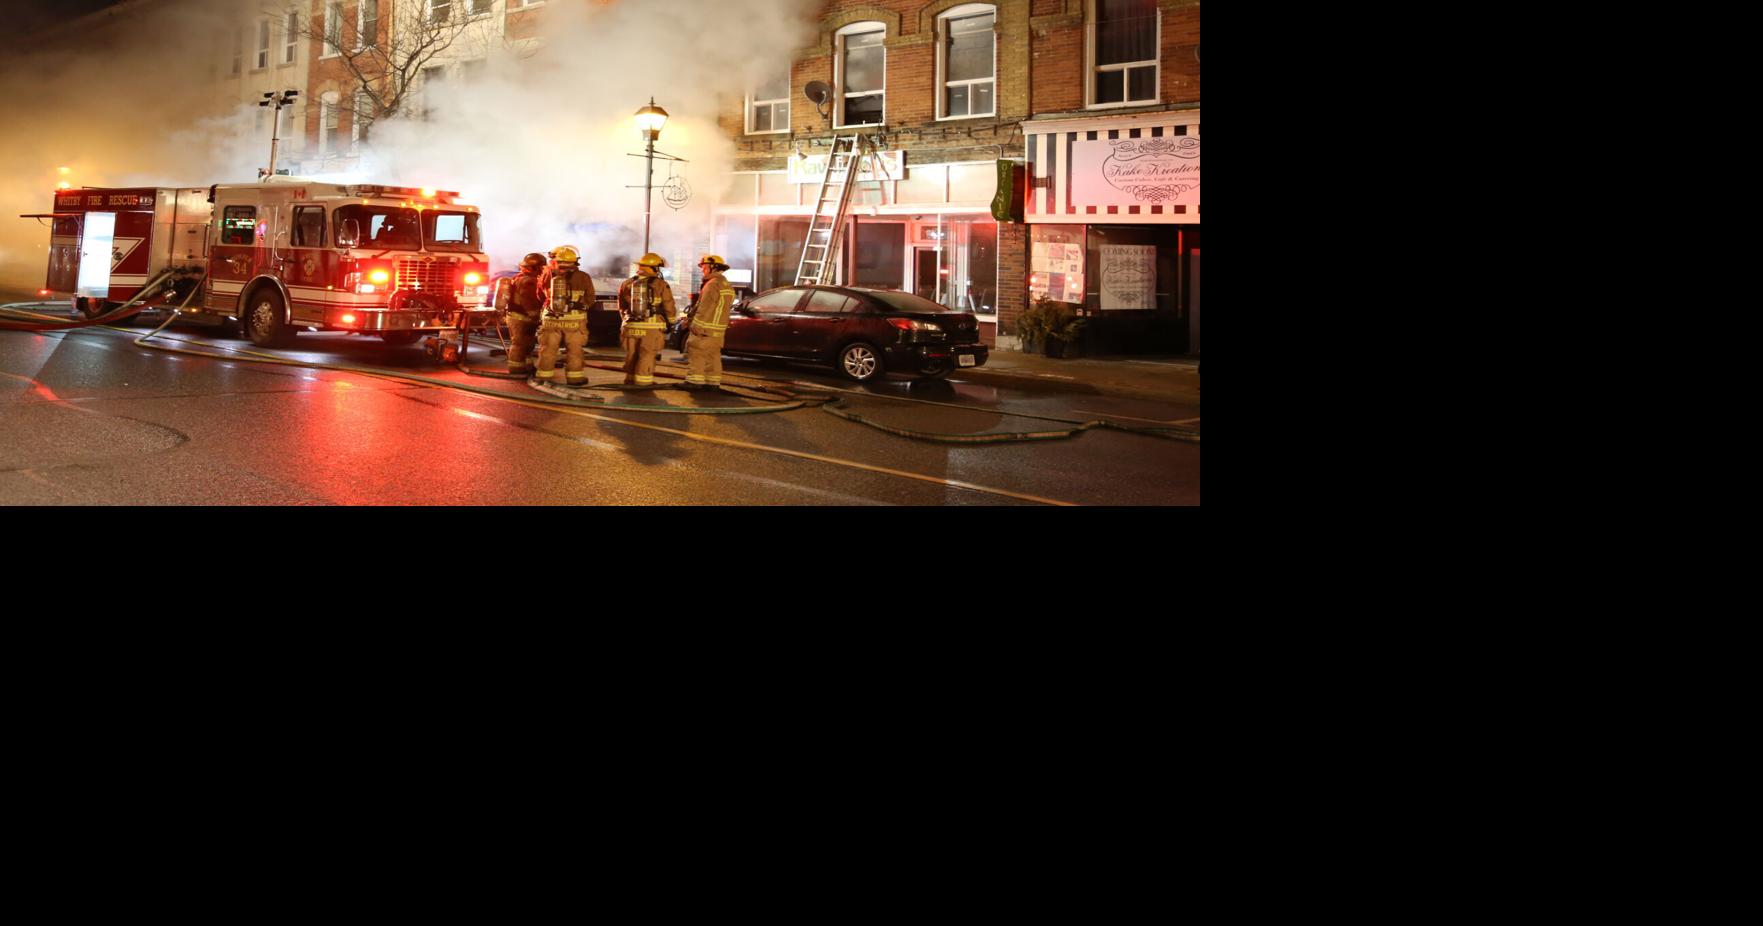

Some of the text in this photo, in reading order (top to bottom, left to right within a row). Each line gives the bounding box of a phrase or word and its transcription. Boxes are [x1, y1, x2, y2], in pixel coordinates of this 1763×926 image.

[1111, 164, 1142, 176] Kake
[58, 194, 138, 206] WHITBY FIRE RESCUE
[232, 262, 247, 275] 34
